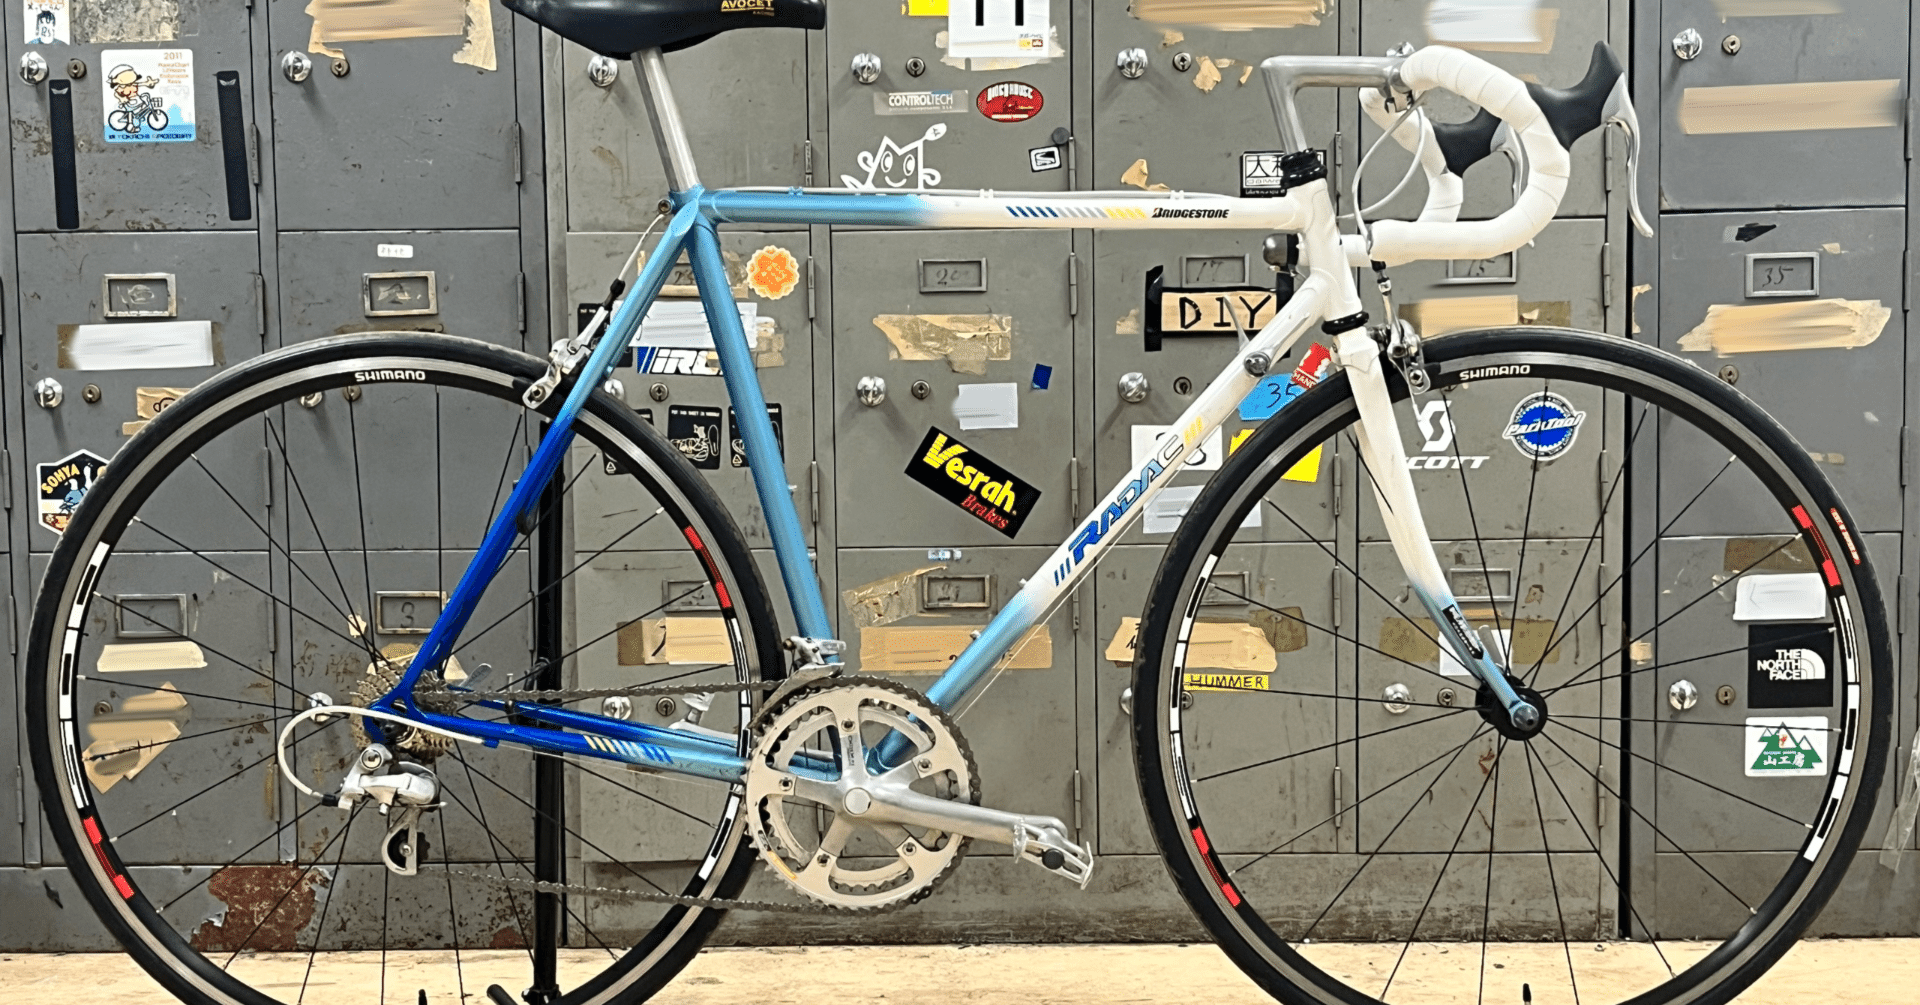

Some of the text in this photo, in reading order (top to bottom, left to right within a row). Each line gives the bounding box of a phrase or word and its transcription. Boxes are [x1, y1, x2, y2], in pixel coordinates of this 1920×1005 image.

[1152, 207, 1230, 218] BRIDGESTONE
[354, 370, 426, 382] SHIMANO
[1459, 365, 1531, 381] SHIMANO
[1404, 456, 1490, 469] COTT
[41, 463, 80, 494] SOHYA
[923, 433, 1016, 514] Vesrah
[1068, 434, 1184, 566] RADAC
[961, 494, 1008, 529] Brakes
[1775, 649, 1801, 659] THE
[1757, 660, 1801, 671] NORTH
[1769, 670, 1801, 680] FACE
